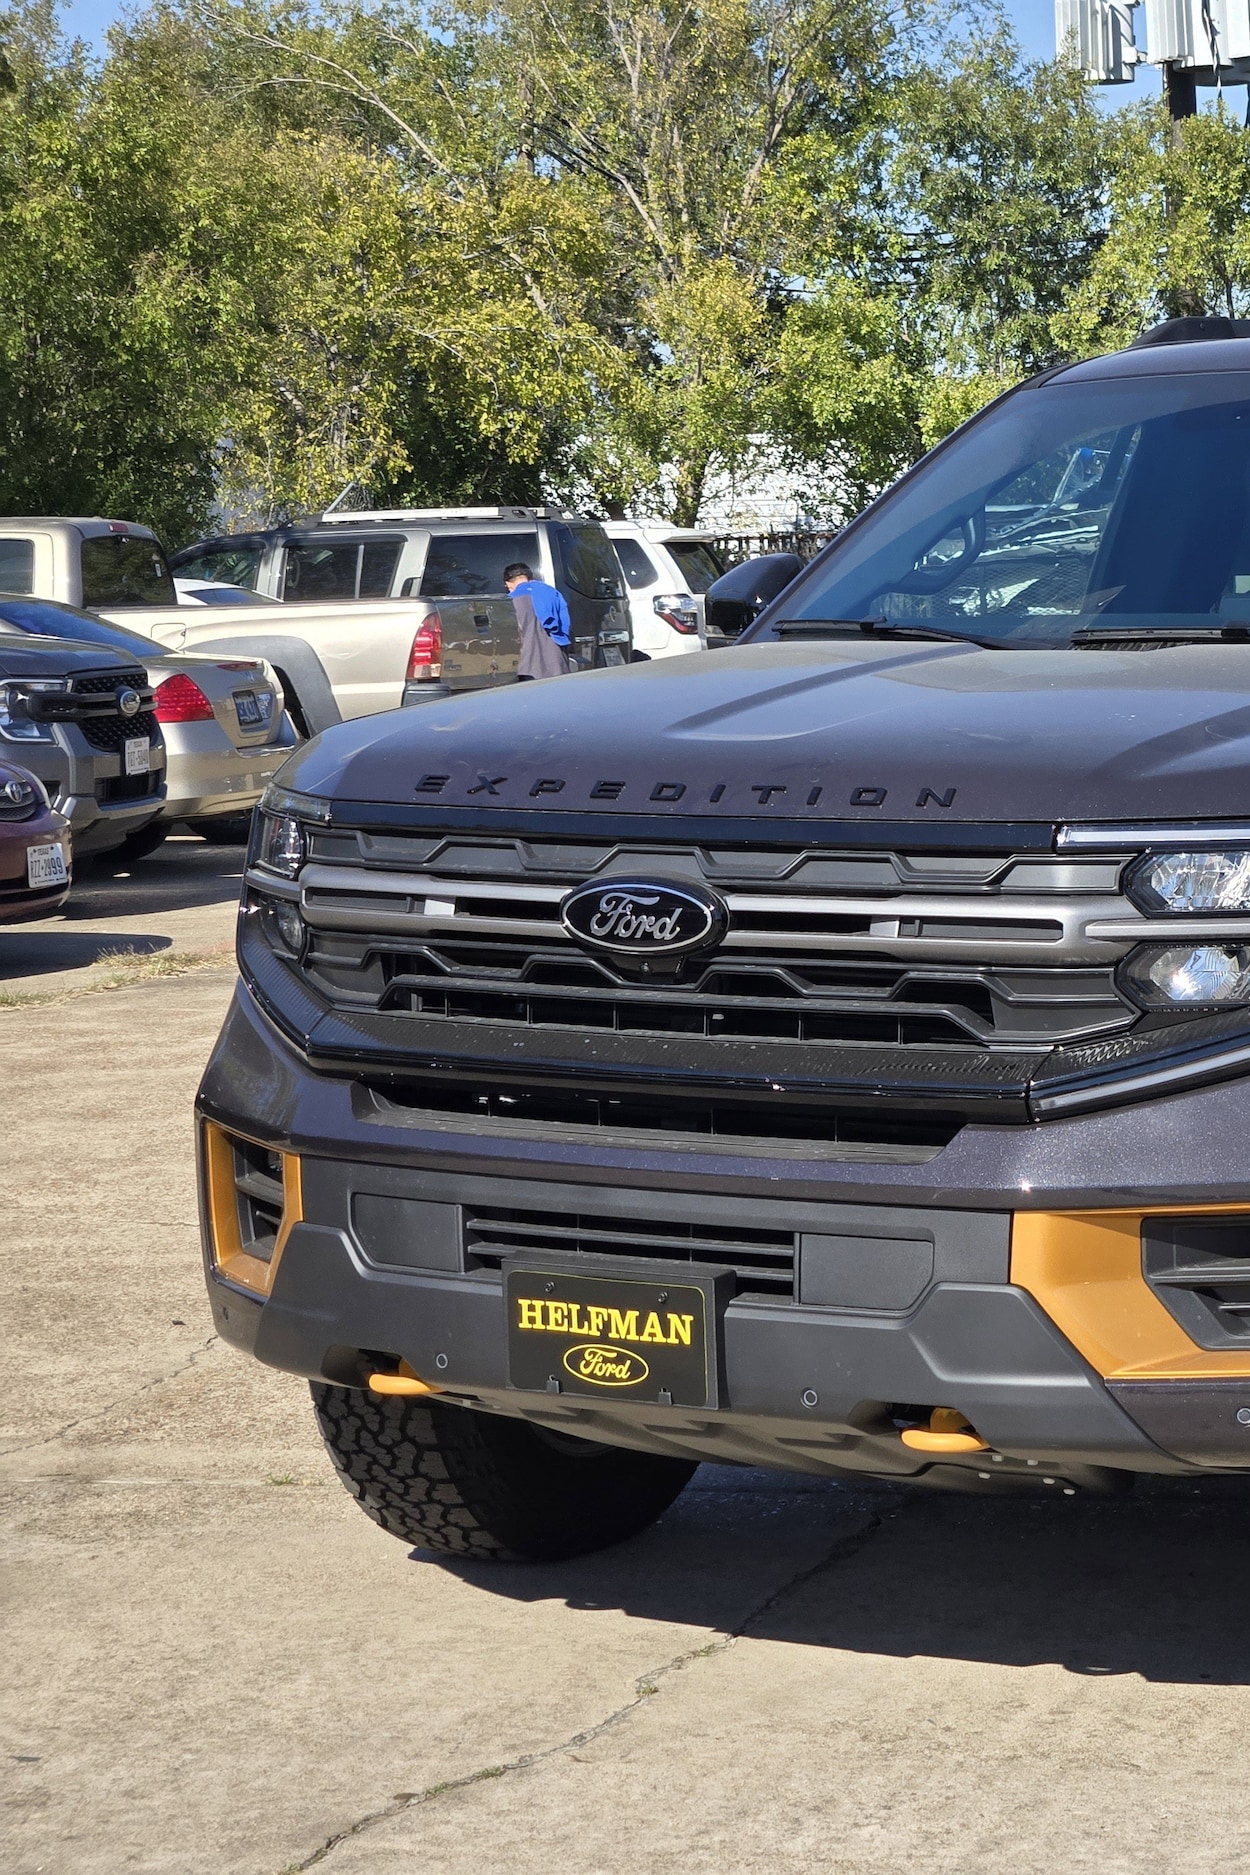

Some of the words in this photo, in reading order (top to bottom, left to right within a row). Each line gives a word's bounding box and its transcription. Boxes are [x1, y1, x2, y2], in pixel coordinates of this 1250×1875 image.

[414, 774, 957, 809] EXPEDITION
[590, 891, 684, 941] Ford
[517, 1298, 694, 1345] HELFMAN
[579, 1347, 632, 1380] Ford
